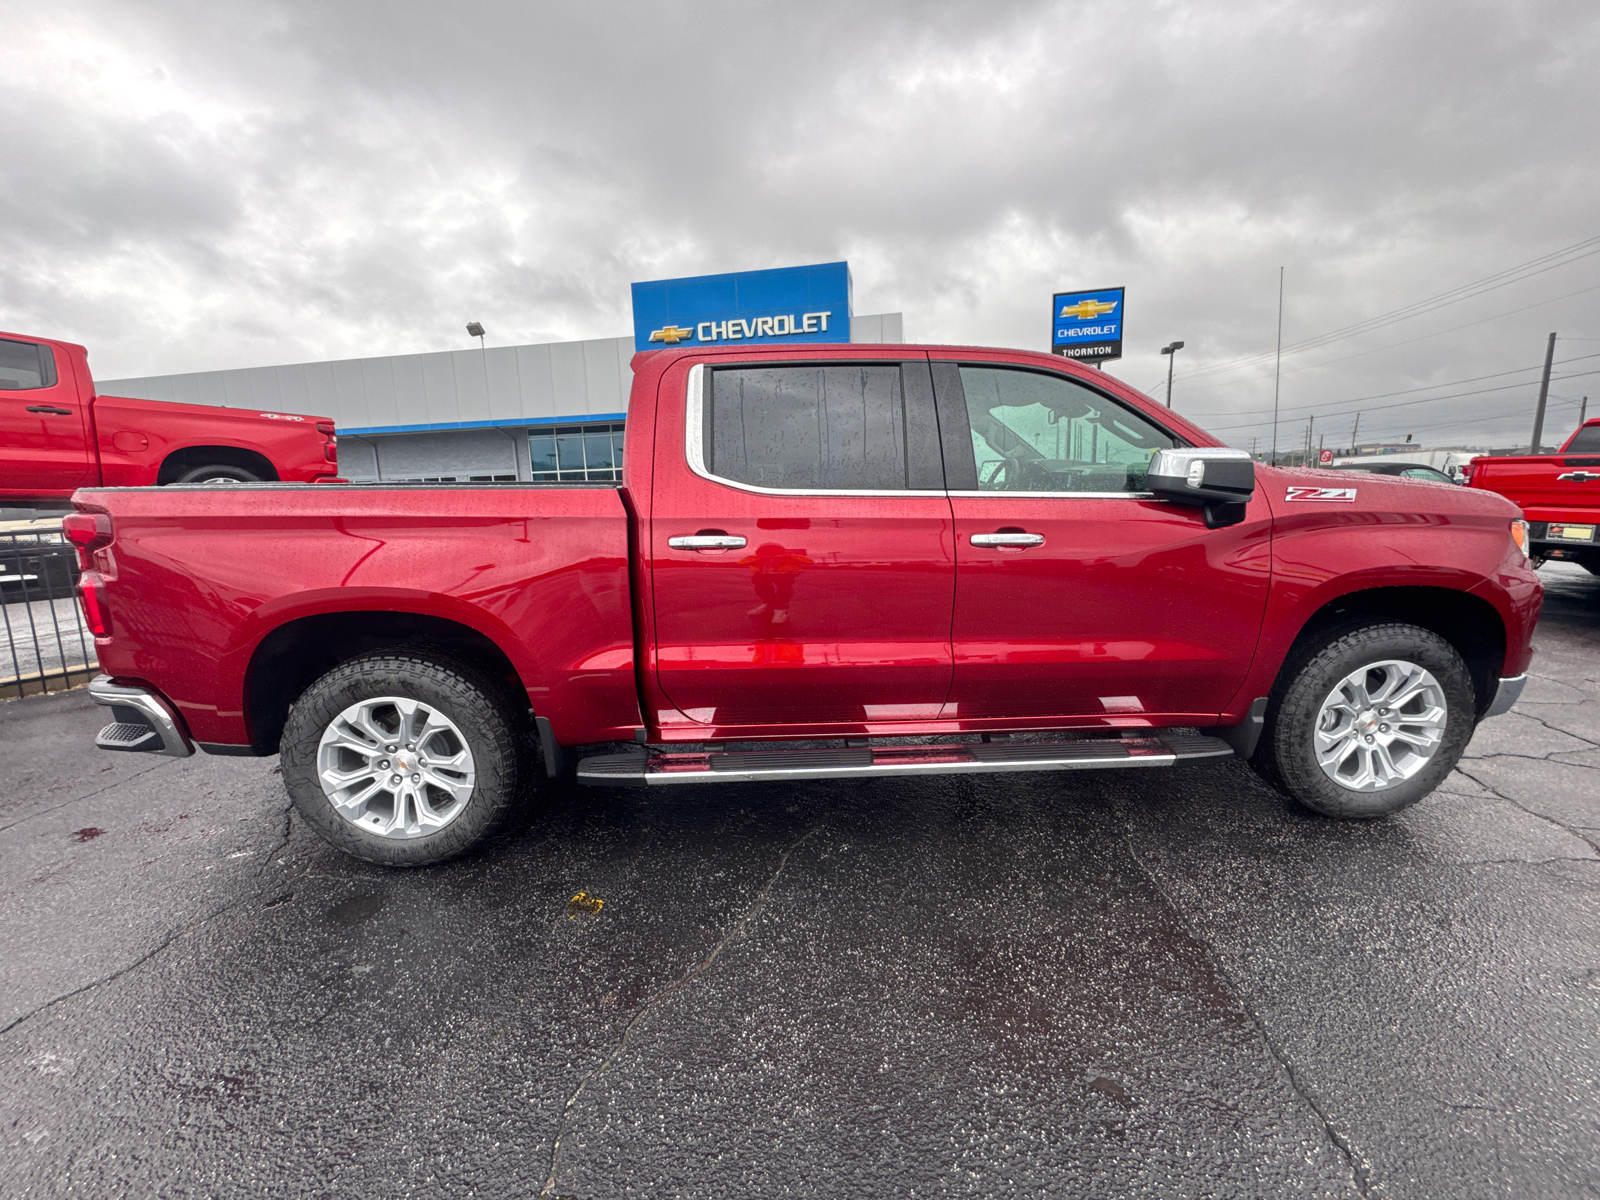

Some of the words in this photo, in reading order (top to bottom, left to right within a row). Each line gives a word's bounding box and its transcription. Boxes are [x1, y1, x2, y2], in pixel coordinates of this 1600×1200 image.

[697, 311, 831, 342] CHEVROLET
[1057, 324, 1117, 338] CHEVROLET
[1062, 346, 1112, 357] THORNTON
